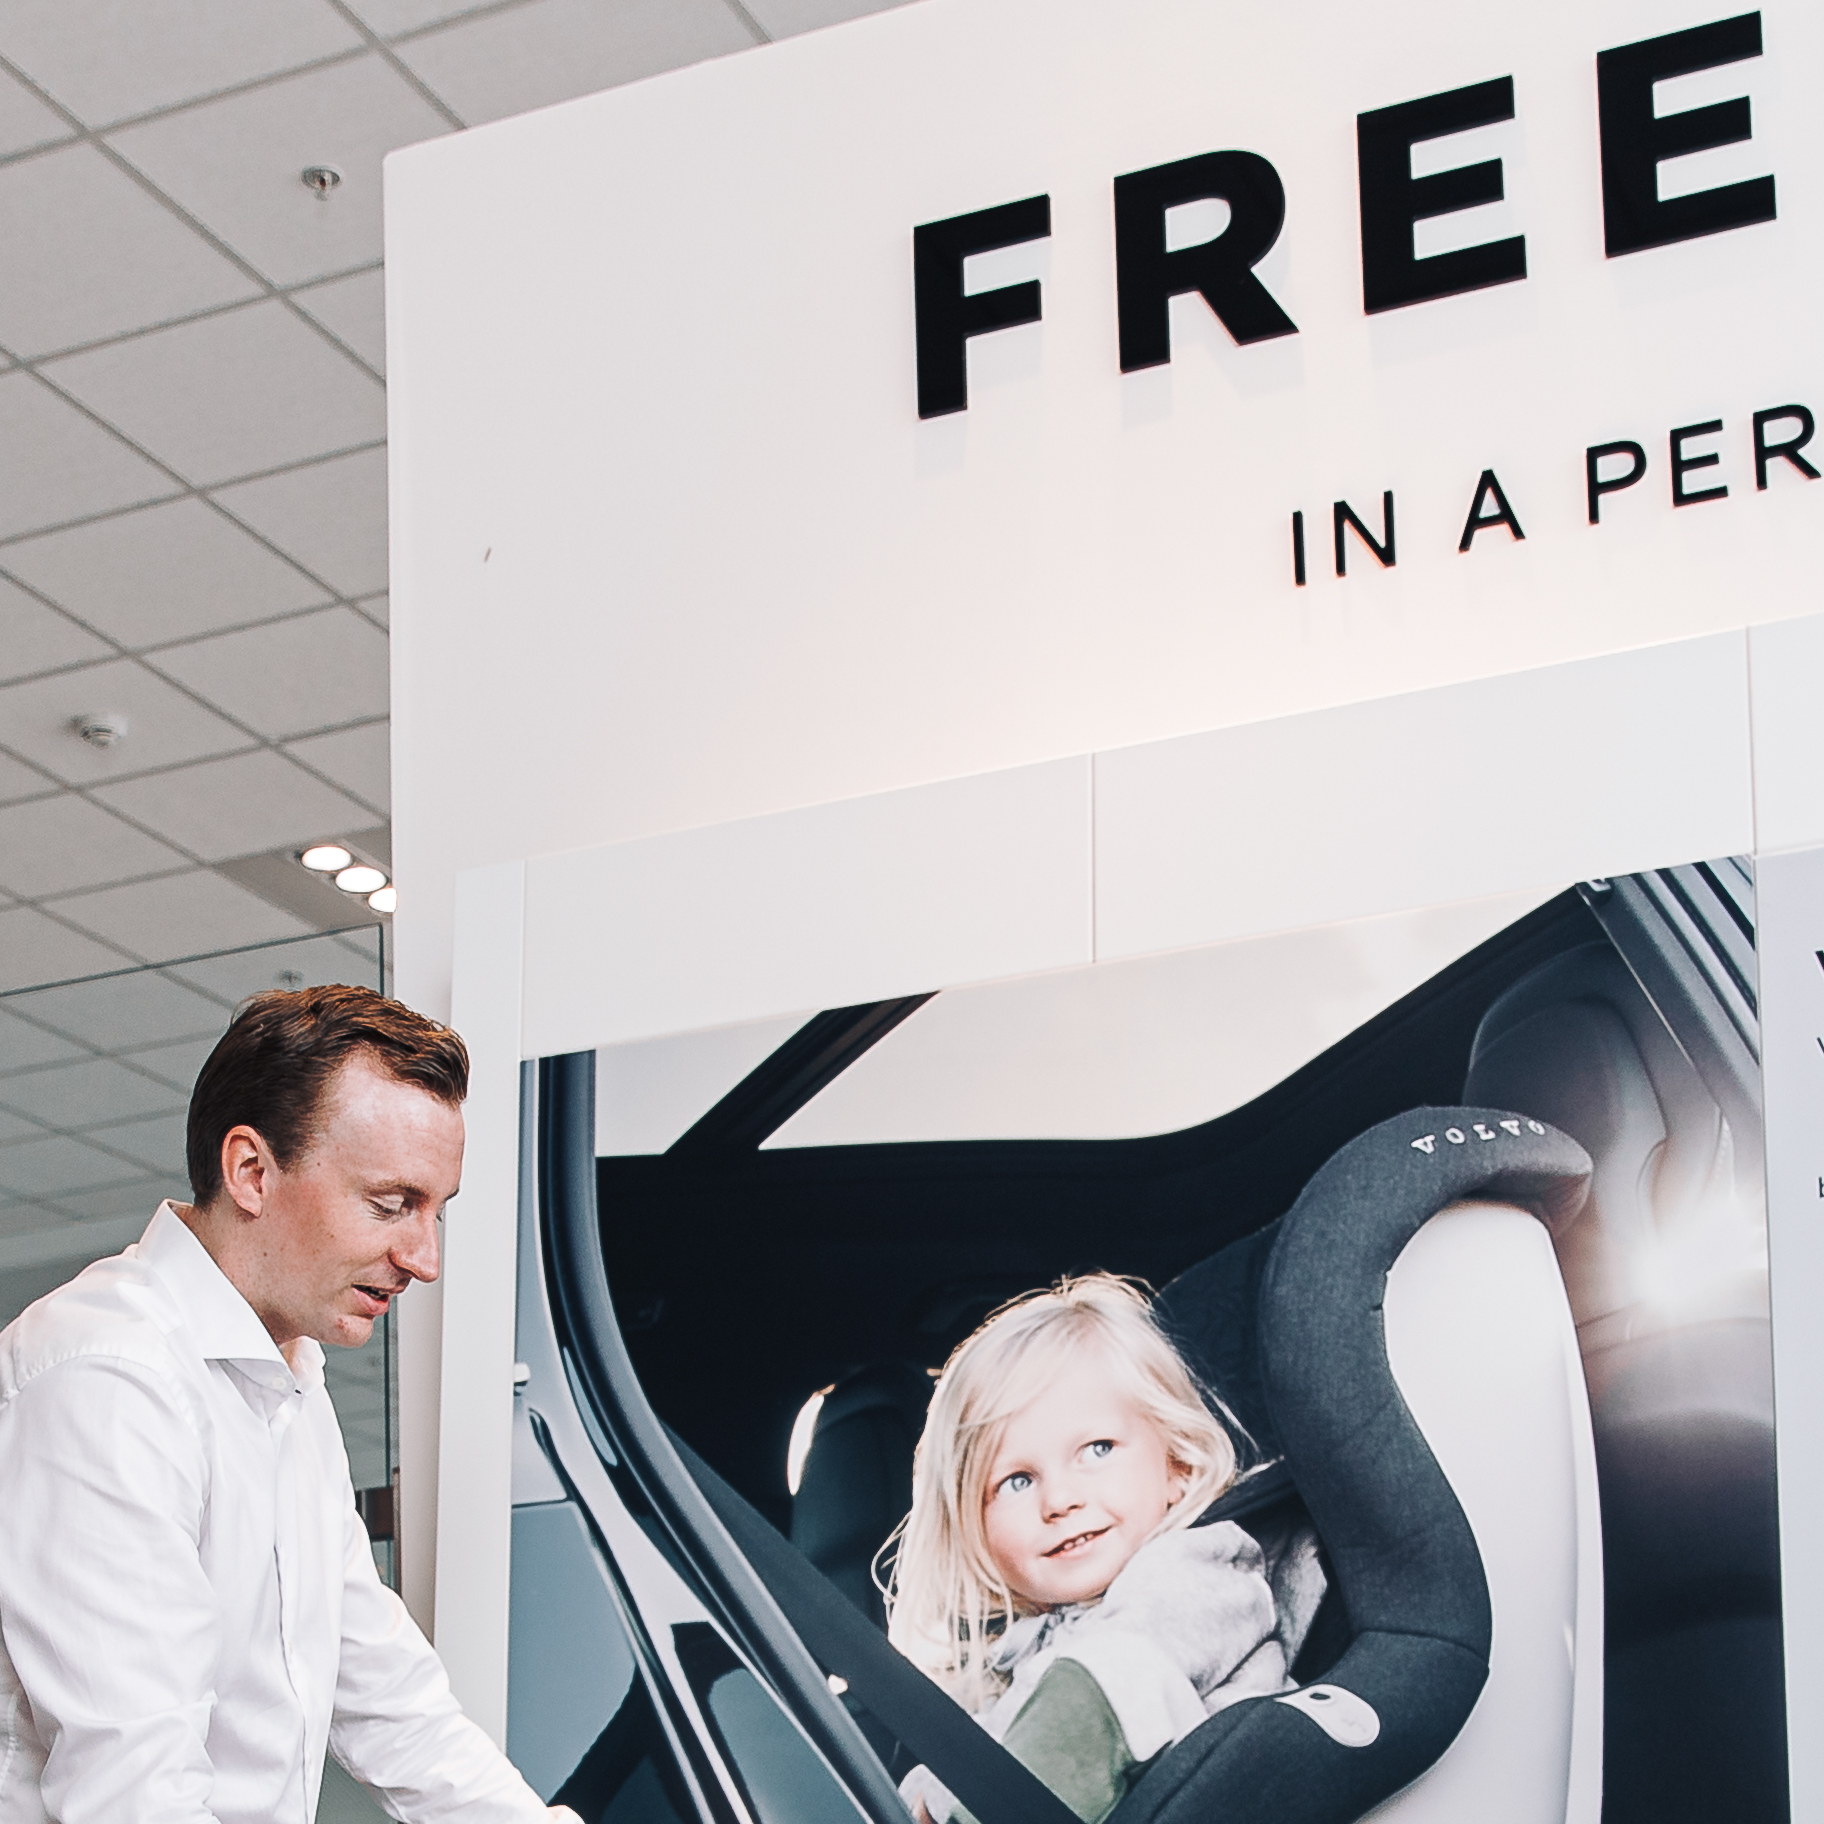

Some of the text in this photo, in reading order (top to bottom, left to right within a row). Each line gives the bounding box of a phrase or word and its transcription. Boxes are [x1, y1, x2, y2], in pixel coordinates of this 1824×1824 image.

[1292, 490, 1396, 586] IN
[1458, 468, 1526, 553] A
[1410, 1118, 1546, 1155] VOLVO
